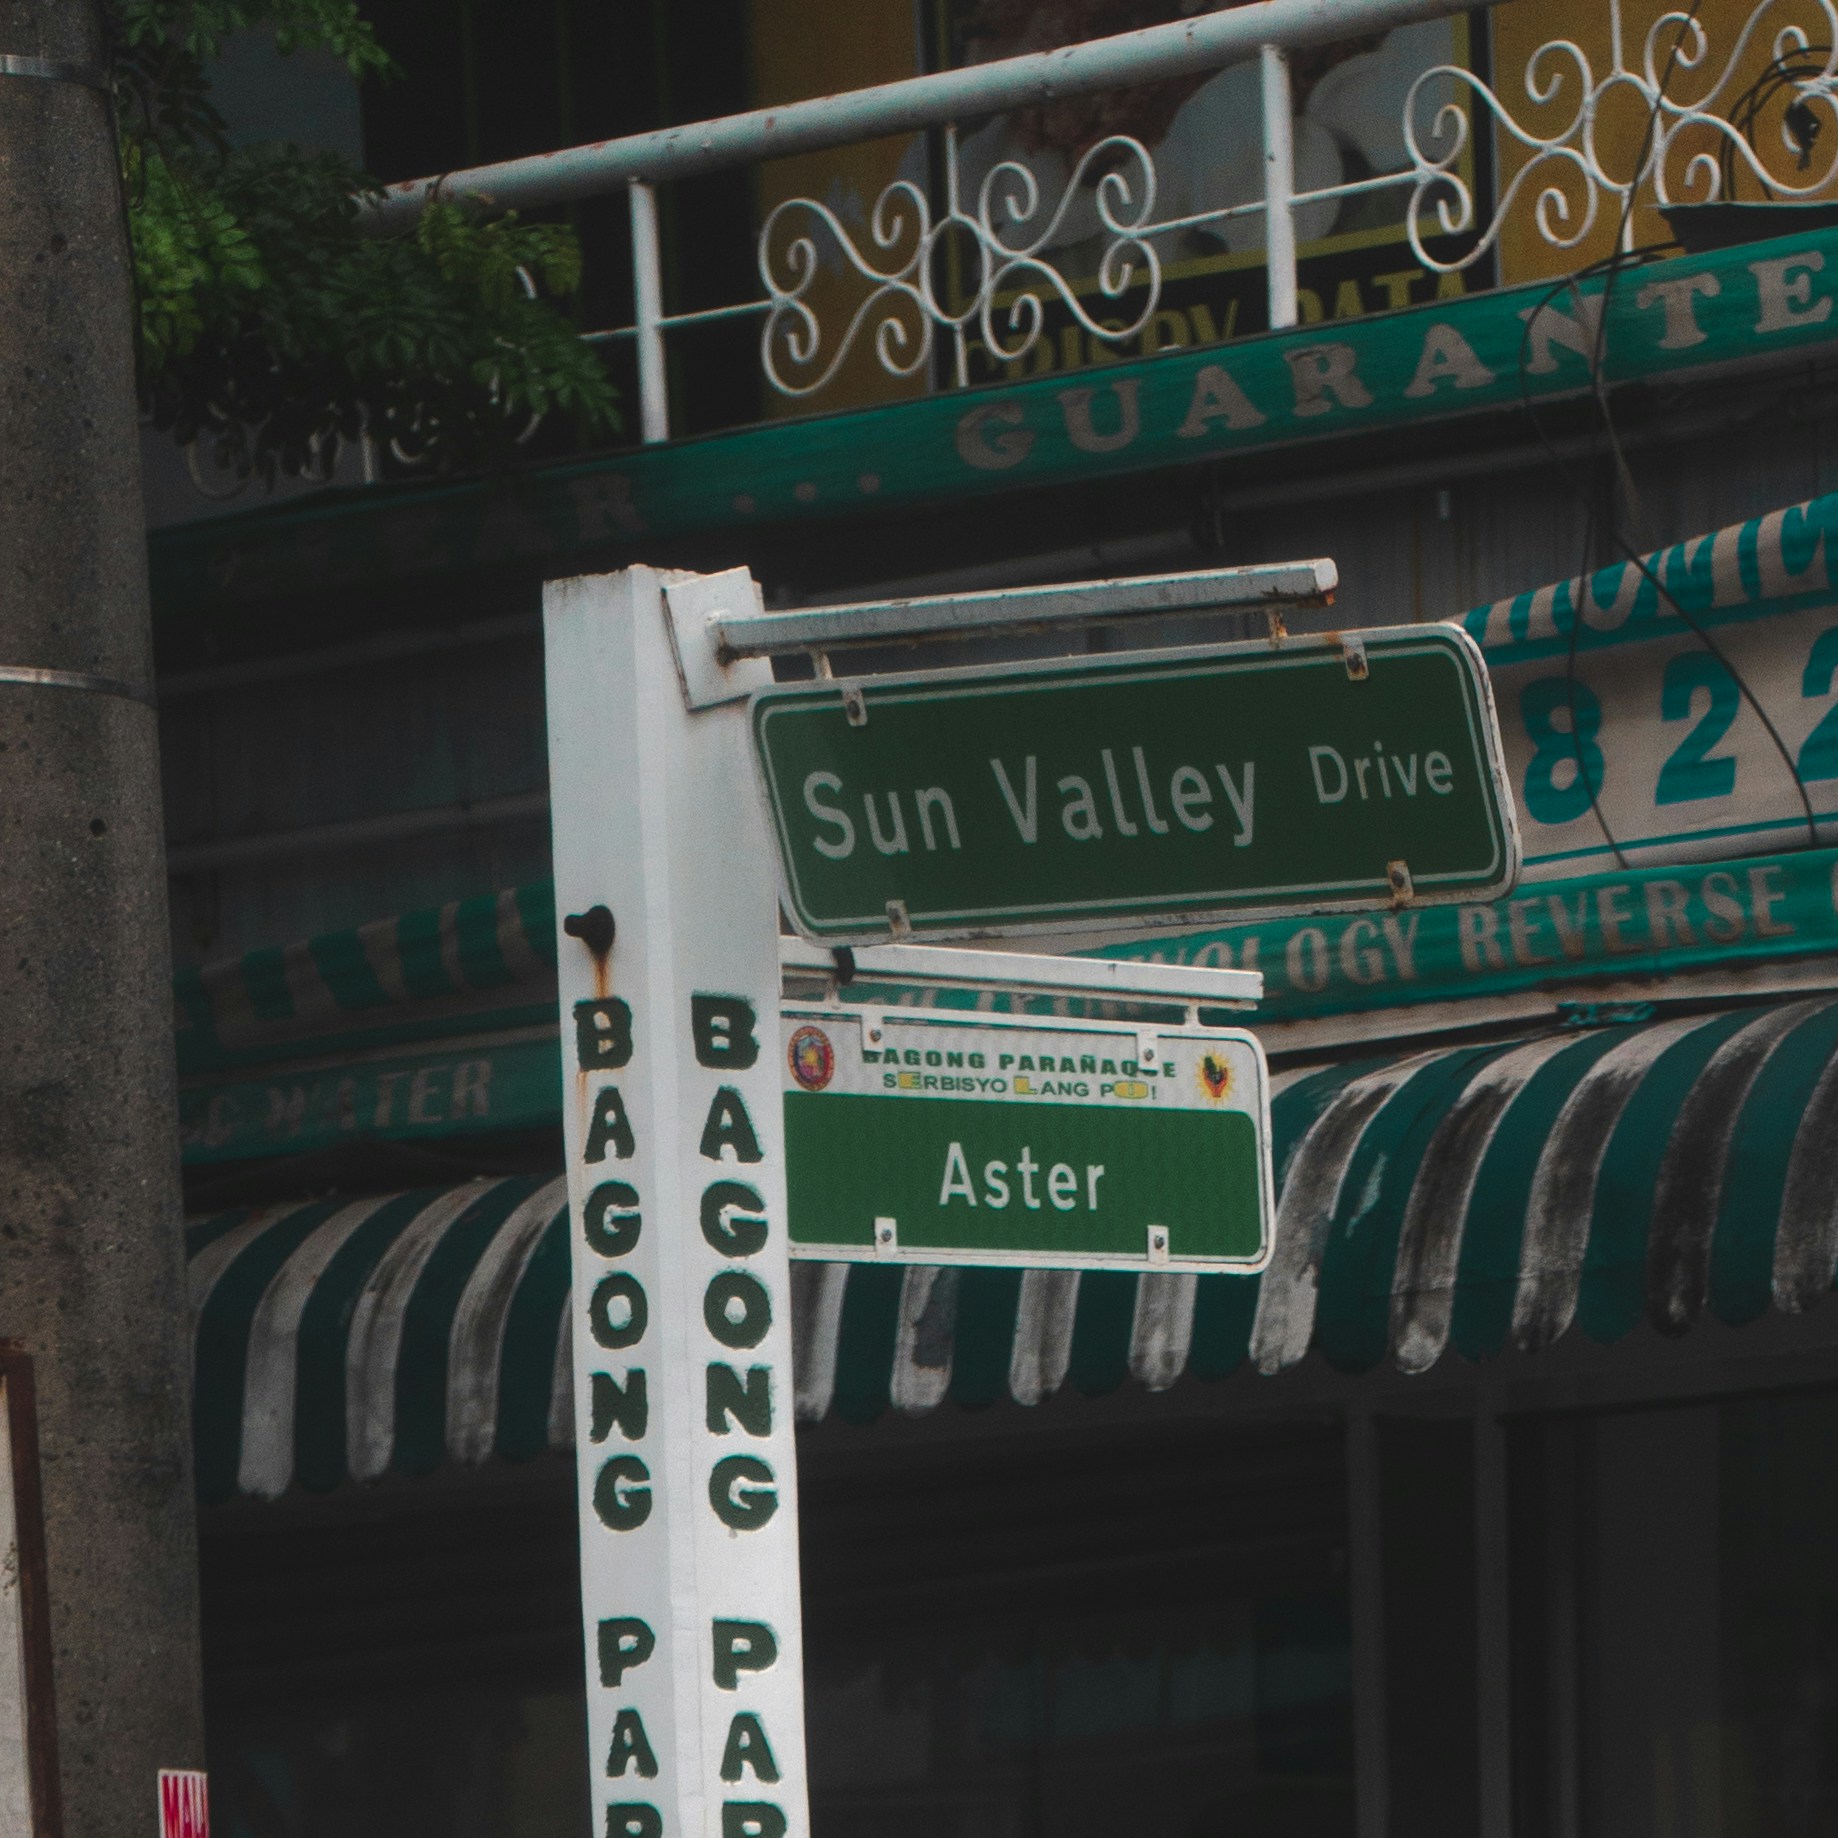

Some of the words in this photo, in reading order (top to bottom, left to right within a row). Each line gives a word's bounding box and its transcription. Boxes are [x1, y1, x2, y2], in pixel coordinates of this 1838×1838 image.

[803, 770, 961, 860] Sun
[990, 745, 1257, 847] Valley
[1308, 741, 1455, 804] Drive
[1456, 862, 1798, 974] REVERSE
[999, 1054, 1177, 1078] PARAÑAQE
[938, 1141, 1106, 1213] Aster
[572, 997, 653, 1532] BAGONG
[691, 993, 778, 1532] BAGONG
